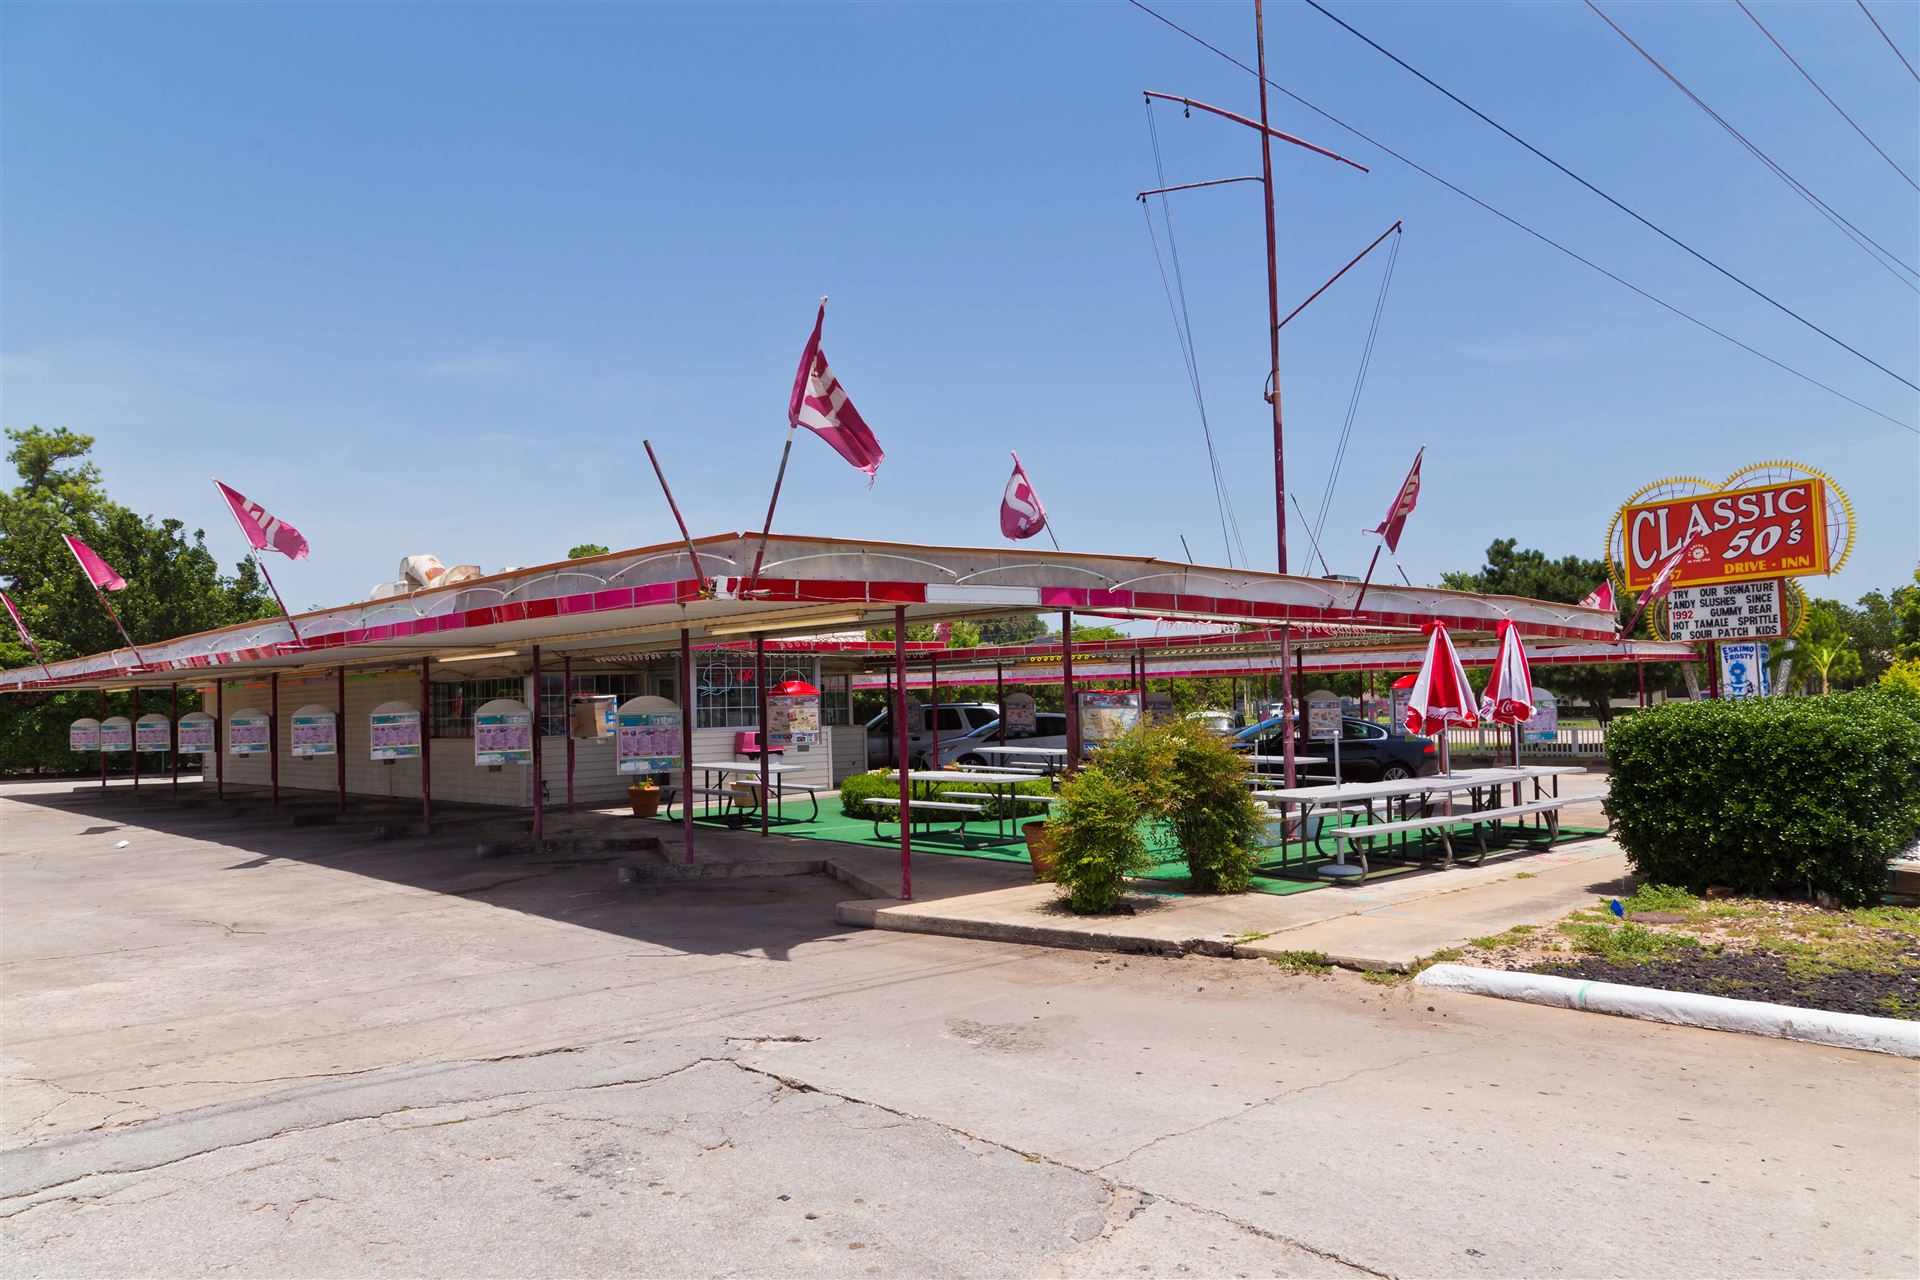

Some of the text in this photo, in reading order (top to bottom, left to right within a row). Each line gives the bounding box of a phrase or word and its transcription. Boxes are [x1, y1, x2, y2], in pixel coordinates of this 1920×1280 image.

[1631, 488, 1808, 570] CLASSIC
[1721, 518, 1804, 559] 50's
[1723, 559, 1767, 575] DRIVE
[1781, 555, 1810, 569] INN
[1673, 582, 1774, 600] TRY OUR SIGNATURE
[1668, 593, 1772, 610] CANDY SLUSHES SINCE
[1672, 604, 1772, 620] 1992 GUMMY BEAR
[1673, 614, 1778, 630] HOT TAMALE SPRITTLE
[1670, 625, 1777, 641] OR SOUR PATCH KIDS
[1721, 645, 1755, 655] ESKIMO
[1723, 654, 1754, 663] FROSTY
